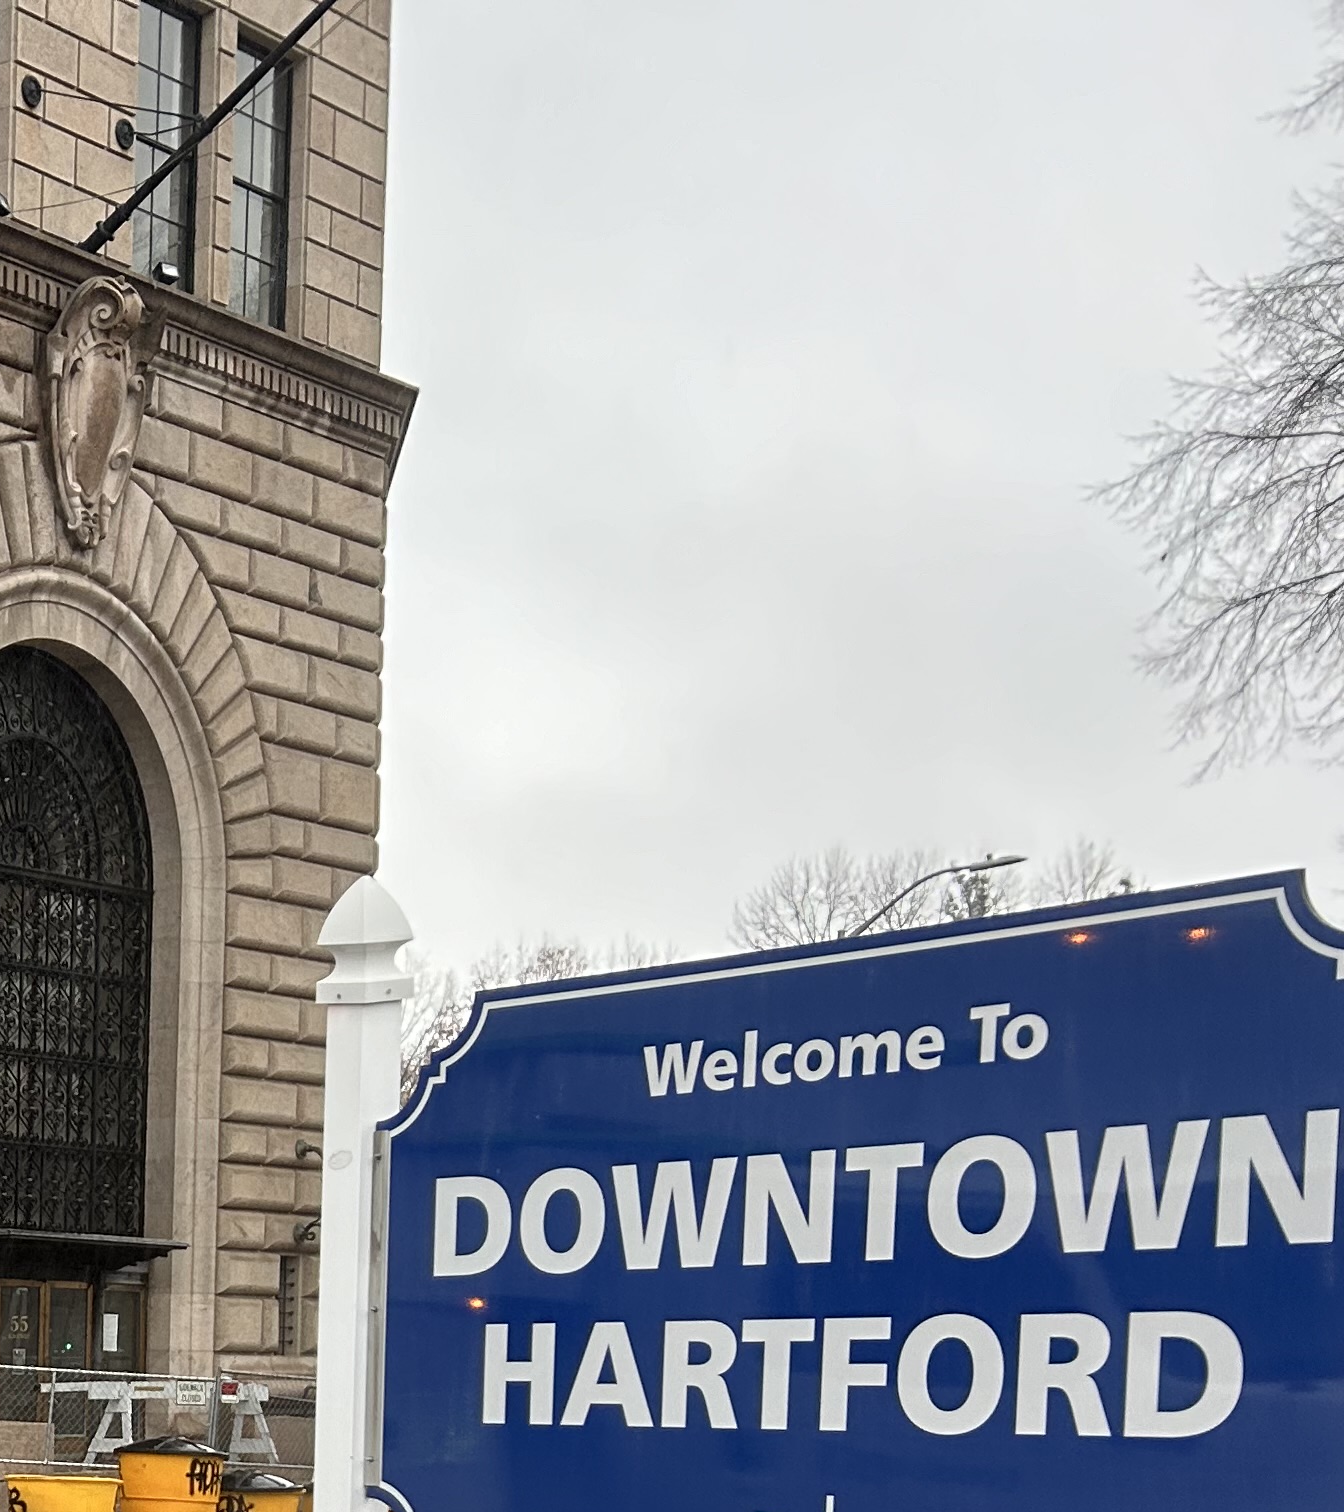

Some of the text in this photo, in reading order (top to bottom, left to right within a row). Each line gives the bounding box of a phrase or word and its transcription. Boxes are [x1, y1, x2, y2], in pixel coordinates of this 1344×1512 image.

[643, 1003, 1049, 1097] Welcome To
[432, 1108, 1340, 1277] DOWNTOWN
[11, 1315, 29, 1332] 55
[482, 1311, 1244, 1438] HARTFORD
